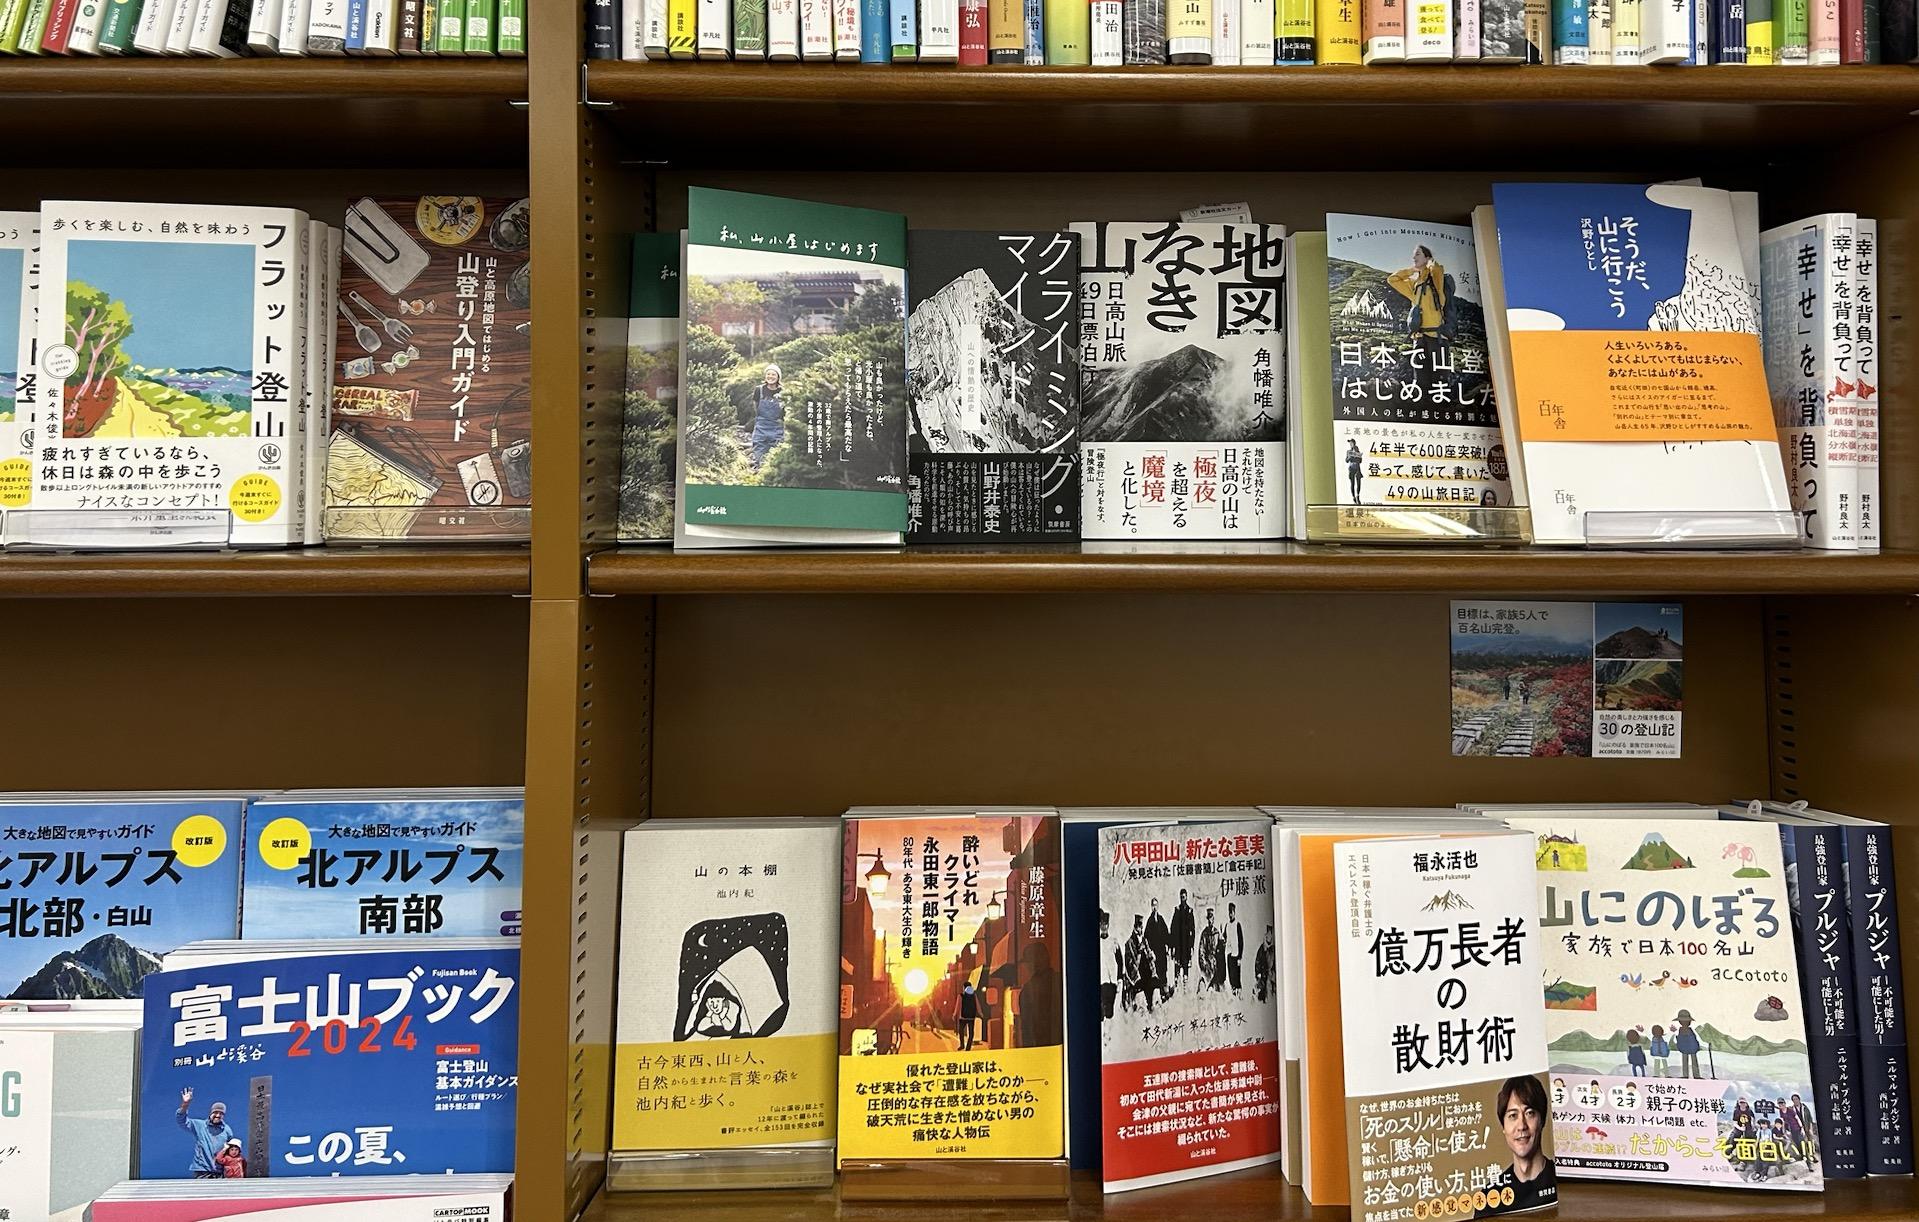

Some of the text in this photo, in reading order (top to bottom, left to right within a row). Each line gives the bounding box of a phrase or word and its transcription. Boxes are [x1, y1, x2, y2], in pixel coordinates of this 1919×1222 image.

[374, 12, 382, 38] Gakken
[403, 0, 416, 39] 昭文社
[931, 26, 949, 34] 平凡社
[53, 218, 250, 235] 歩くを楽しむ、自然を味わう
[719, 225, 879, 261] 私、山小屋はじめます
[1400, 228, 1437, 237] Mountain
[1079, 222, 1138, 279] 山
[1581, 217, 1597, 271] 沢野ひとし
[1619, 216, 1650, 290] そうだ、
[1141, 222, 1206, 333] なき
[1208, 224, 1286, 339] 地図
[1597, 216, 1626, 318] 山に行こう
[481, 256, 497, 373] 山と高原地図ではじめる
[1832, 226, 1853, 372] 「幸せ」を背負って
[1856, 232, 1874, 374] 「幸せ」を背負って
[251, 224, 289, 437] フラット登山
[998, 235, 1036, 404] マインド
[1103, 282, 1127, 363] 日高山脈
[450, 253, 480, 442] 山登り入門ガイド
[1340, 341, 1484, 374] 日本で山登
[1604, 341, 1689, 351] 人生いろいろある。
[1607, 354, 1743, 366] くよくよしていてもはじまらない、
[1252, 347, 1275, 429] 角幡唯介
[1608, 368, 1704, 379] あなたには山がある。
[1797, 225, 1818, 540] 「幸せ」を背負って
[1828, 429, 1857, 438] 北海道
[1834, 418, 1853, 427] 単独
[42, 446, 209, 461] 疲れすぎているなら、
[1087, 449, 1095, 483] 冒険登山
[1369, 441, 1488, 460] 4年半で600座突破!
[1790, 434, 1799, 497] 野村良太
[41, 464, 221, 480] 休日は森の中を歩こう
[243, 478, 268, 486] GUIDE
[1140, 449, 1168, 508] 「魔境」
[1191, 449, 1219, 509] 「極夜」
[1242, 447, 1252, 494] それだけで
[1368, 462, 1490, 481] 登って、感じて、書いた
[40, 483, 222, 492] 散歩以上ロングトレイル未満の新しいアウトドアのすすめ
[77, 494, 218, 509] ナイスなコンセプト!
[984, 461, 1001, 533] 山野井泰史
[1121, 461, 1138, 534] と化した。
[1171, 462, 1188, 528] を超える
[1222, 448, 1239, 529] 日高の山は
[1387, 485, 1476, 501] 49の山旅日記
[1839, 493, 1849, 529] 野村良太
[1861, 494, 1871, 529] 野村良太
[1457, 608, 1549, 621] 目標は、家族5人で
[1458, 622, 1521, 635] 百名山完登。
[1599, 723, 1675, 737] 30の登山記
[3, 824, 156, 841] 大きな地図で見やすいガイド
[185, 836, 213, 846] 改訂版
[271, 839, 299, 849] 改訂版
[328, 821, 477, 839] 大きな地図で見やすいガイド
[297, 843, 505, 889] 北アルプス
[1113, 834, 1266, 866] 八甲田山 新たな真実
[1413, 849, 1479, 873] 福永活也
[1814, 834, 1829, 886] 最強登山家
[1866, 834, 1880, 886] 最強登山家
[695, 864, 777, 878] 山の本棚
[962, 836, 980, 906] 酔いどれ
[1128, 858, 1266, 881] 発見された「佐藤書簡」と「倉石手記」
[1445, 872, 1471, 881] Fukunaga
[901, 836, 914, 958] 80年代 ある東大生の輝き
[922, 836, 939, 956] 永田東一郎物語
[943, 854, 960, 941] クライマー
[1028, 866, 1046, 939] 藤原章生
[1348, 854, 1360, 938] エベレスト登頂自伝
[1361, 854, 1373, 937] 日本一稼ぐ弁護士の
[1540, 885, 1780, 939] 山にのぼる
[0, 896, 152, 938] 北部・白山
[359, 893, 444, 935] 南部
[1813, 887, 1841, 971] プルジャ
[1865, 886, 1892, 970] プルジャ
[1367, 916, 1527, 977] 億万長者
[1561, 931, 1755, 957] 家族で日本100名山
[432, 968, 478, 977] Fujisan Book
[1711, 967, 1788, 983] accototo
[170, 965, 515, 1047] 富士山ブック
[1437, 977, 1467, 1010] の
[1821, 976, 1835, 1037] 可能にした男
[287, 1015, 418, 1057] 2024
[1391, 1016, 1516, 1074] 散財術
[174, 1057, 193, 1068] 別冊
[436, 1060, 489, 1074] 富士登山
[637, 1051, 766, 1070] 古今東西、山と人、
[906, 1061, 1003, 1078] 優れた登山家は、
[1143, 1060, 1259, 1087] 五連隊の捜索隊として、遭難後、
[2, 1071, 21, 1117] G
[435, 1075, 519, 1090] 基本ガイダンス
[637, 1068, 798, 1091] 自然から生まれた言葉の森を
[1644, 1083, 1687, 1095] で始めた
[1837, 1047, 1853, 1122] ニルマル・プルジャ
[1887, 1058, 1901, 1132] ニルマル・プルジャ
[636, 1092, 736, 1111] 池内紀と歩く。
[866, 1106, 1034, 1127] 破天荒に生きた憎めない男の
[867, 1090, 1039, 1111] 圧倒的な存在感を放ちながら、
[1360, 1092, 1460, 1113] なぜ、世界のお金持ちたちは
[1445, 1101, 1483, 1116] におカネを
[1580, 1095, 1600, 1107] 4才
[1616, 1097, 1637, 1108] 2才
[1646, 1096, 1728, 1115] 親子の挑戦
[912, 1125, 990, 1142] 痛快な人物伝
[1360, 1106, 1444, 1141] 「死のスリル」
[1591, 1113, 1611, 1123] 天候
[1616, 1114, 1636, 1125] 体力
[1641, 1114, 1685, 1128] トイレ問題
[285, 1125, 407, 1166] この夏、
[1361, 1142, 1377, 1154] 賢く
[1362, 1161, 1433, 1183] 儲け方、稼ぎ方よりも
[1363, 1163, 1513, 1206] お金の使い方、出費に
[1415, 1190, 1514, 1219] 新感覚マネー本
